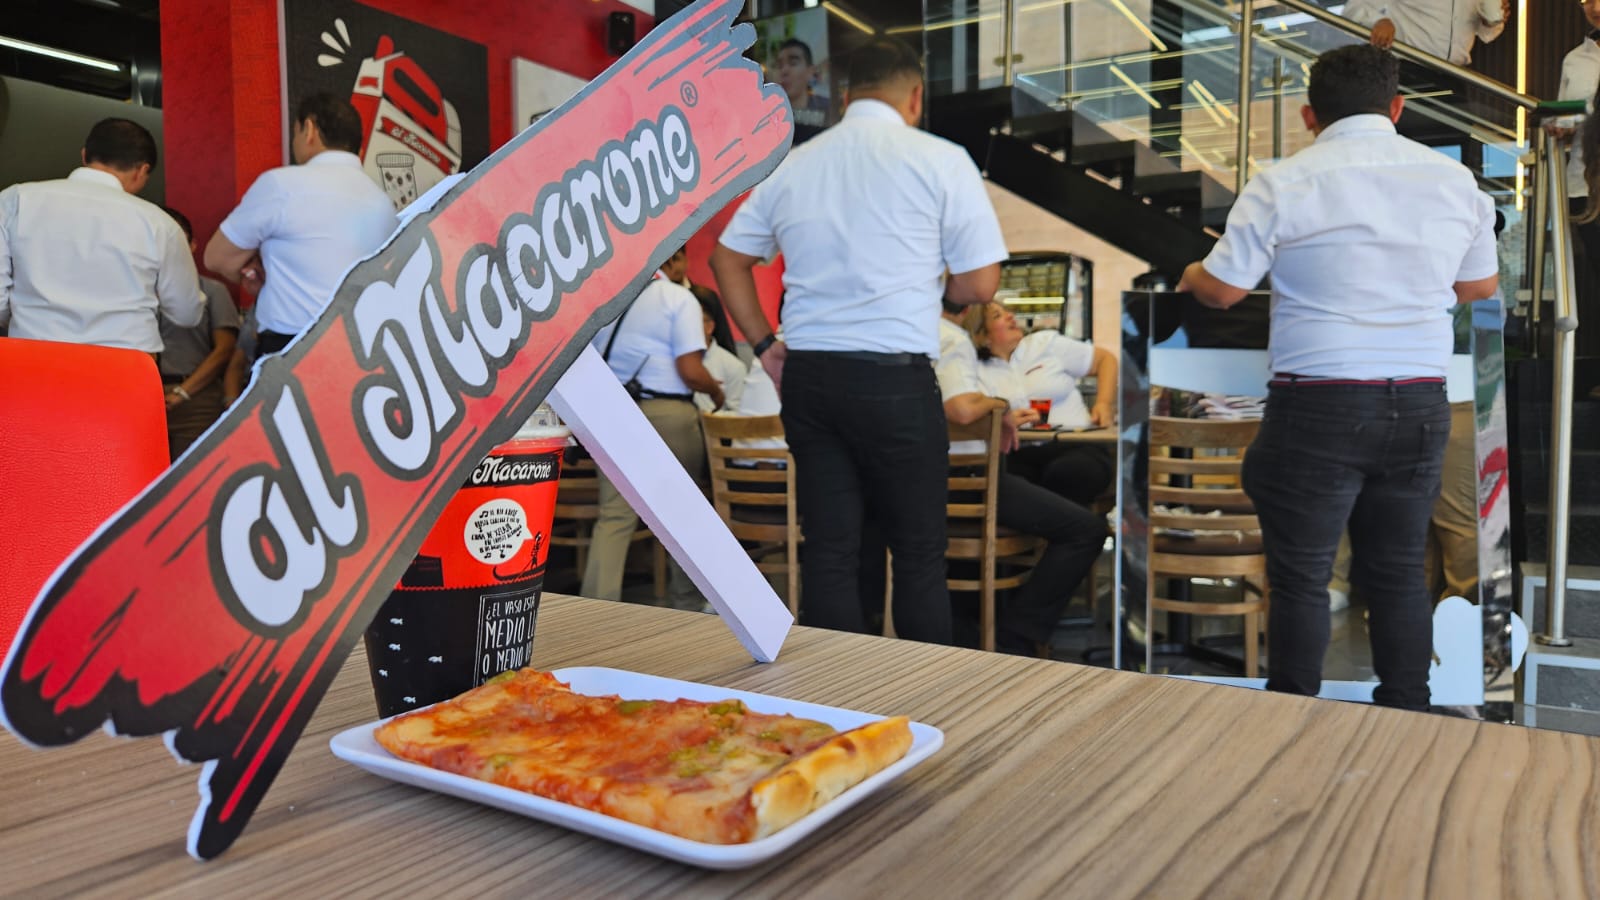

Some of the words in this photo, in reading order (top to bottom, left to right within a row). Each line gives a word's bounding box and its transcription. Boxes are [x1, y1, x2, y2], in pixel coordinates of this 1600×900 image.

[219, 383, 359, 627] al
[353, 112, 696, 471] Macarone
[472, 456, 552, 485] Macarone
[505, 600, 522, 615] VASO
[485, 616, 525, 649] MEDIO
[482, 653, 490, 675] O
[496, 646, 524, 673] MEDIO
